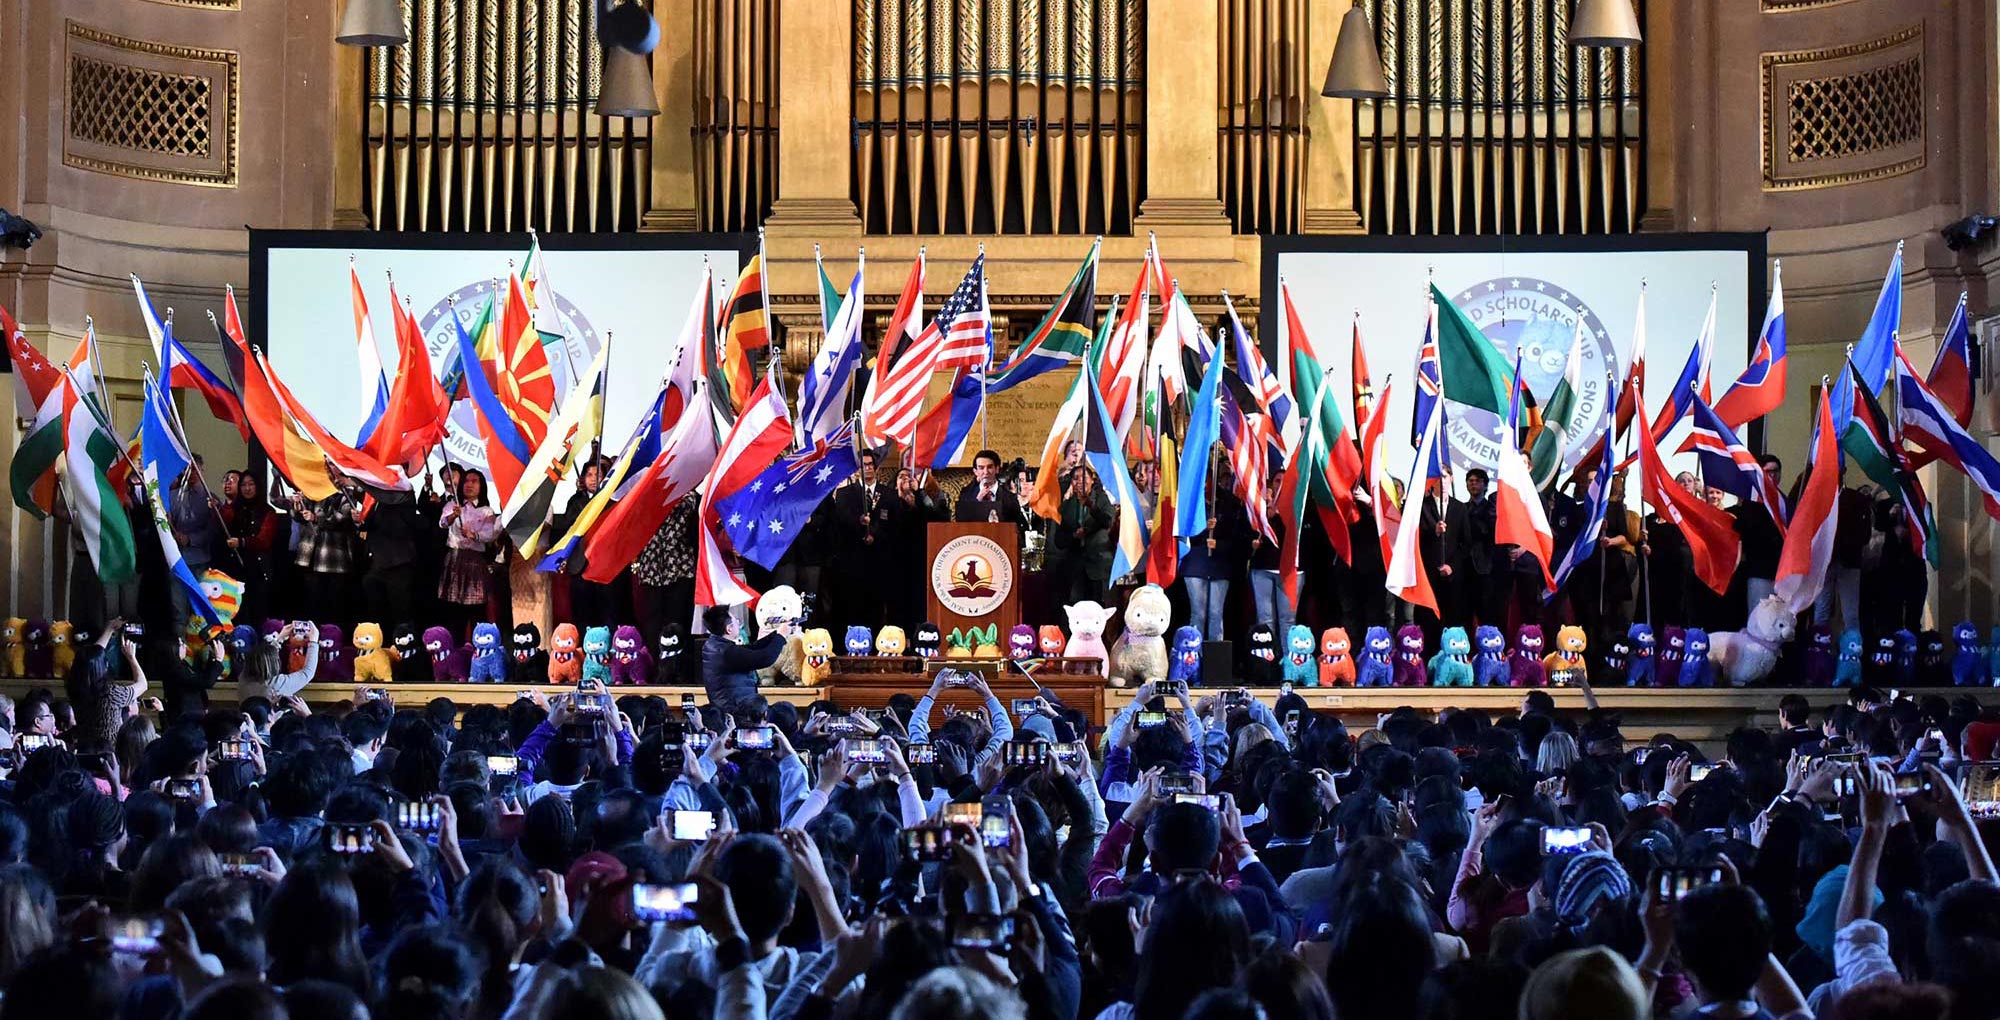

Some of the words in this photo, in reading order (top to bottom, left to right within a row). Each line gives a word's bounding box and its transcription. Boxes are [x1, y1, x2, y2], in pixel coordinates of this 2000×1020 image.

[1485, 296, 1574, 328] SCHOLAR'S
[429, 309, 471, 357] WORD
[1566, 380, 1597, 445] MPIONS
[936, 538, 970, 571] TOURNAMENT
[979, 539, 1009, 571] CHAMPIONS
